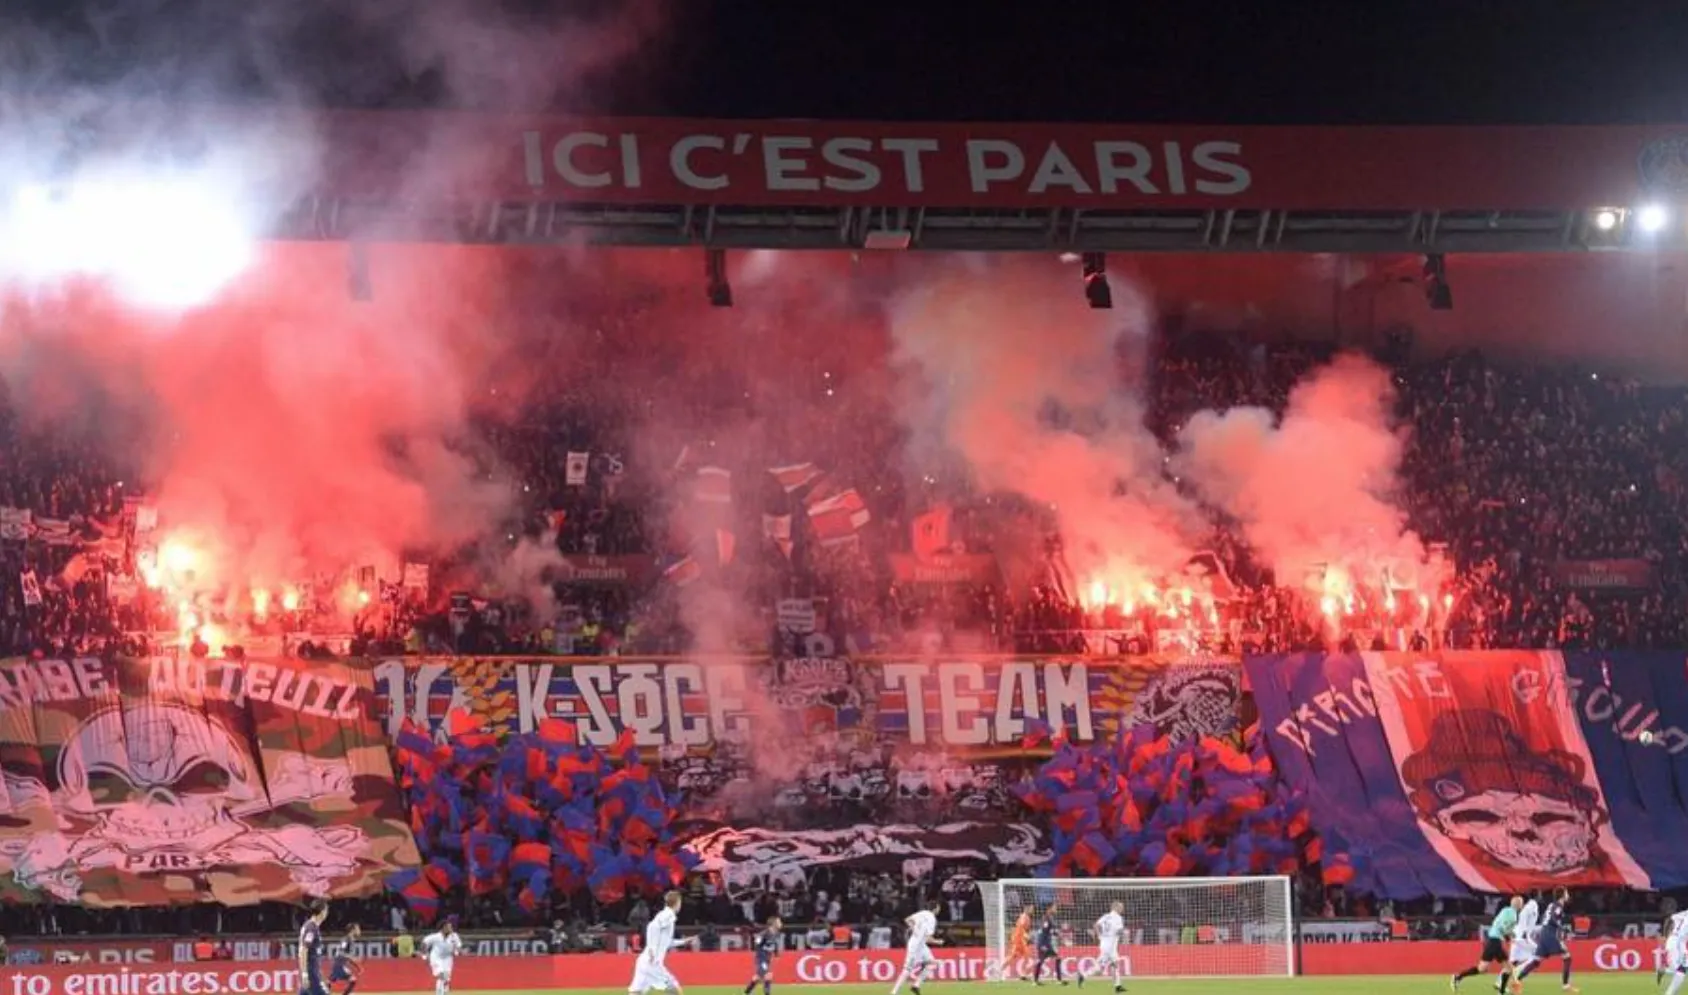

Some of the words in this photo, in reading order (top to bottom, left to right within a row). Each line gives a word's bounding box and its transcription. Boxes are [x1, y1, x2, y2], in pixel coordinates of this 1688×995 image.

[523, 131, 640, 188] ICI
[671, 134, 939, 192] C'EST
[968, 140, 1252, 195] PARIS
[148, 655, 361, 721] AUTEUIL
[883, 662, 1094, 744] TEAM
[796, 955, 847, 982] Go
[857, 956, 896, 981] to
[1594, 943, 1641, 970] Go
[11, 971, 51, 995] to
